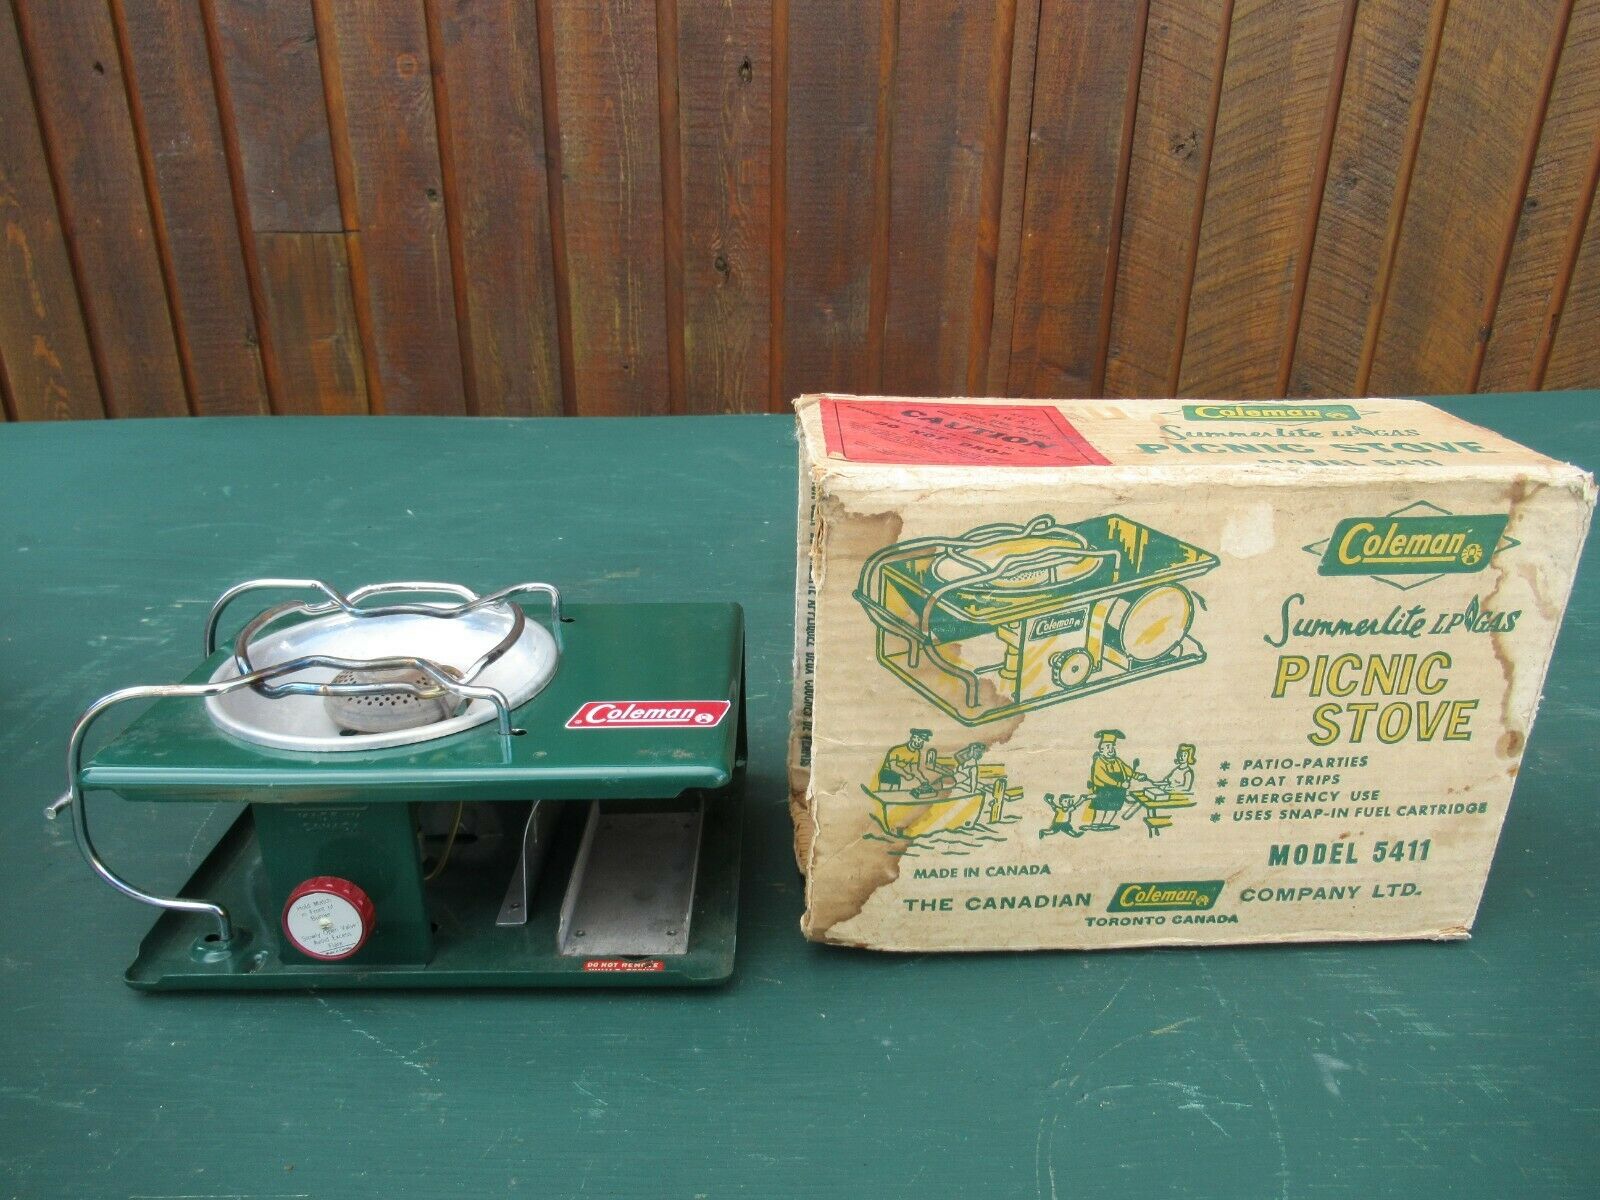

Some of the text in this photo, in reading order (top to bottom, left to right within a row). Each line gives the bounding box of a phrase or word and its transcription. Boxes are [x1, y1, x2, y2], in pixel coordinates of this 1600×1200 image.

[1195, 406, 1321, 418] Coleman
[901, 409, 1057, 449] CAUTION
[1160, 424, 1324, 440] Summerlite
[1136, 441, 1494, 454] PICNIC STOVE
[1338, 522, 1467, 565] Coleman
[1036, 618, 1074, 635] Coleman
[1264, 593, 1426, 648] Summerlite
[1473, 609, 1522, 633] GAS
[1271, 651, 1451, 698] PICNIC
[586, 704, 697, 723] Coleman
[1307, 699, 1480, 746] STOVE
[1242, 755, 1368, 771] PATIO-PARTIES
[1239, 774, 1340, 788] BOAT TRIPS
[1236, 789, 1381, 805] EMERGENCY USE
[1232, 802, 1488, 823] USES SNAP-IN FUEL CARTRIDGE
[1268, 839, 1432, 866] MODEL 5411
[913, 864, 1051, 879] MADE IN CANADA
[903, 883, 1422, 912] THE CANADIAN Coleman COMPANY LTD.
[1085, 914, 1239, 927] TORONTO CANADA
